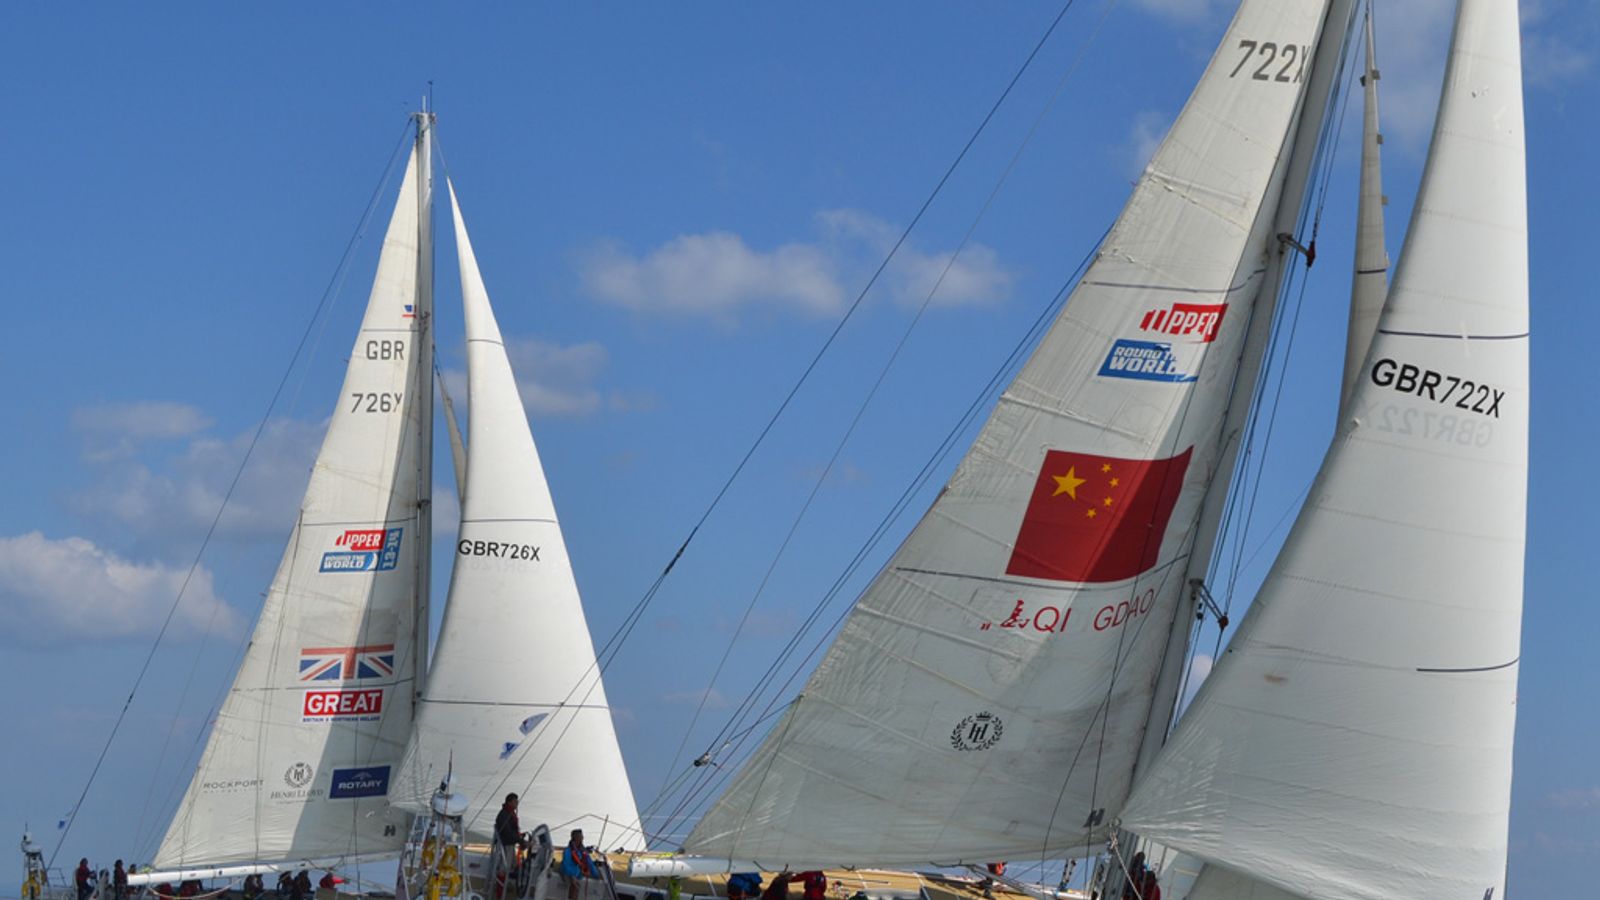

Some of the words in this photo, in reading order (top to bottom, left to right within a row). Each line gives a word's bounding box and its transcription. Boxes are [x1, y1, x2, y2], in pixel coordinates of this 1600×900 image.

[1229, 39, 1311, 84] 722X
[366, 340, 404, 360] GBR
[1113, 346, 1162, 360] ROUND
[1370, 357, 1506, 419] GBR722X
[458, 539, 541, 562] GBR726X
[307, 692, 381, 713] GREAT
[203, 779, 264, 789] ROCKPORT
[338, 779, 383, 790] ROTARY
